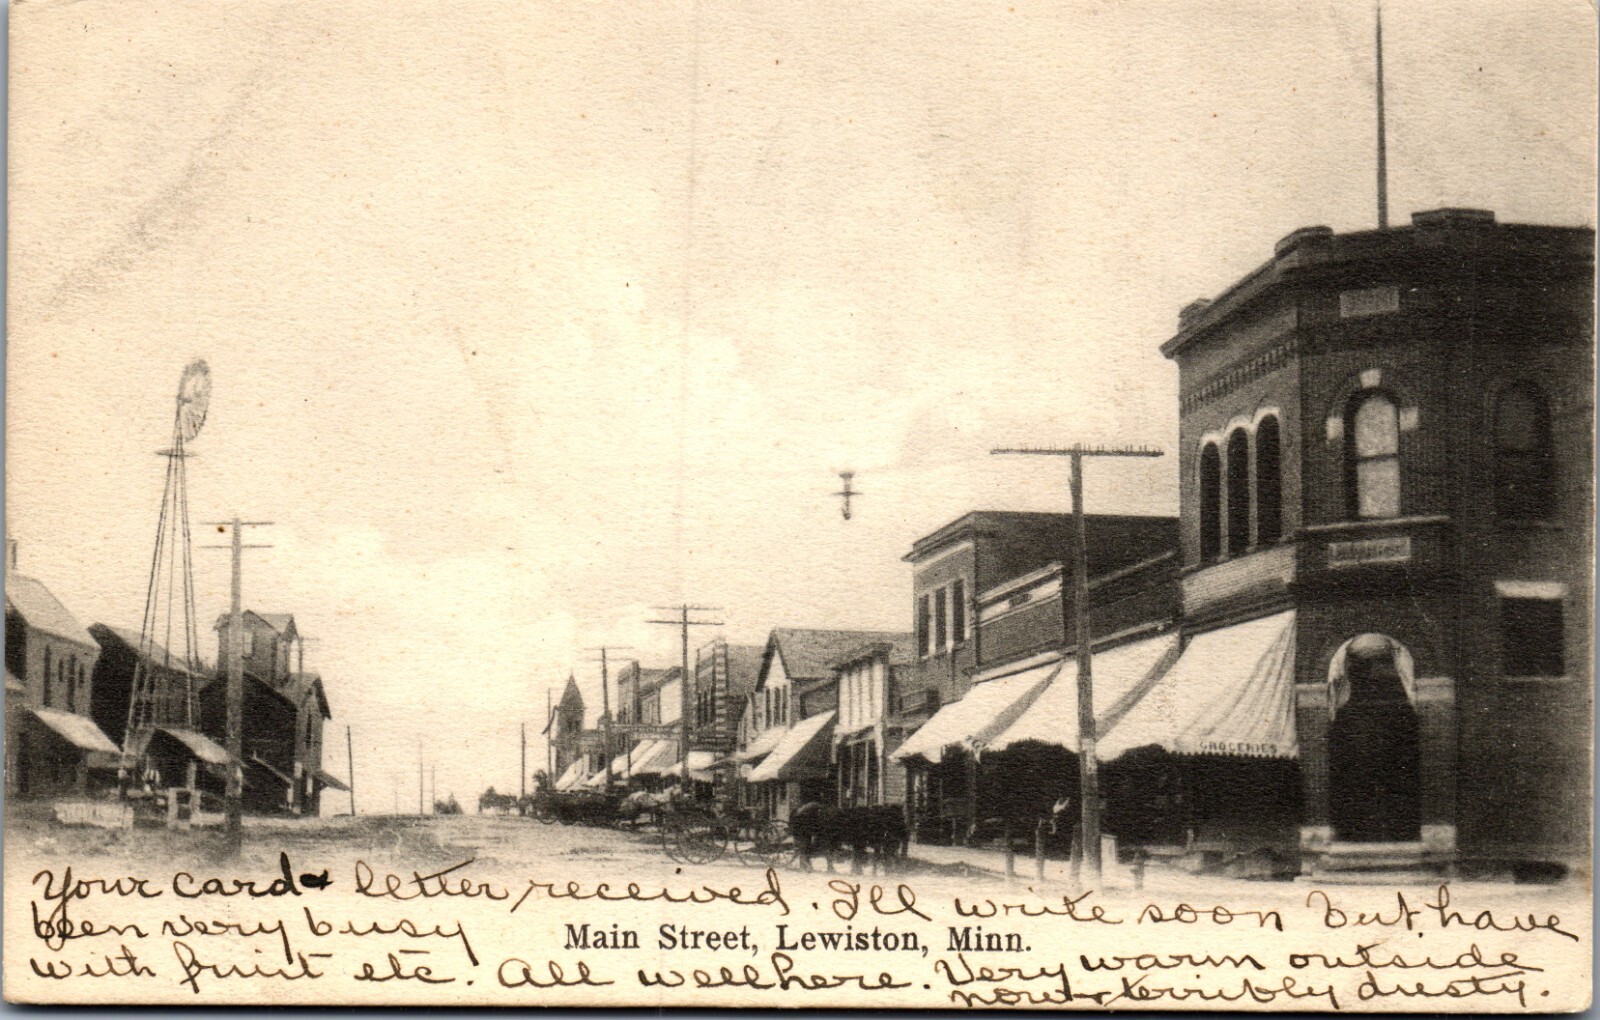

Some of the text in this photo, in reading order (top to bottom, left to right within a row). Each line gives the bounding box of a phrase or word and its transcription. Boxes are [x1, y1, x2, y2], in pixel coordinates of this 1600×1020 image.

[1200, 741, 1278, 753] GROCERIES
[32, 867, 162, 951] Your
[173, 852, 302, 898] card
[355, 857, 509, 900] letter
[954, 886, 1123, 922] write
[1138, 902, 1284, 931] soon
[1425, 885, 1579, 942] have
[32, 901, 480, 967] been very busy
[30, 944, 157, 979] with
[174, 941, 335, 993] fruit
[354, 949, 475, 987] etc.
[497, 958, 615, 989] All
[934, 953, 1074, 1001] Very
[1080, 954, 1266, 972] warm
[1289, 943, 1544, 972] outside
[1103, 974, 1340, 1009] terribly
[1357, 970, 1550, 1008] dusty.
